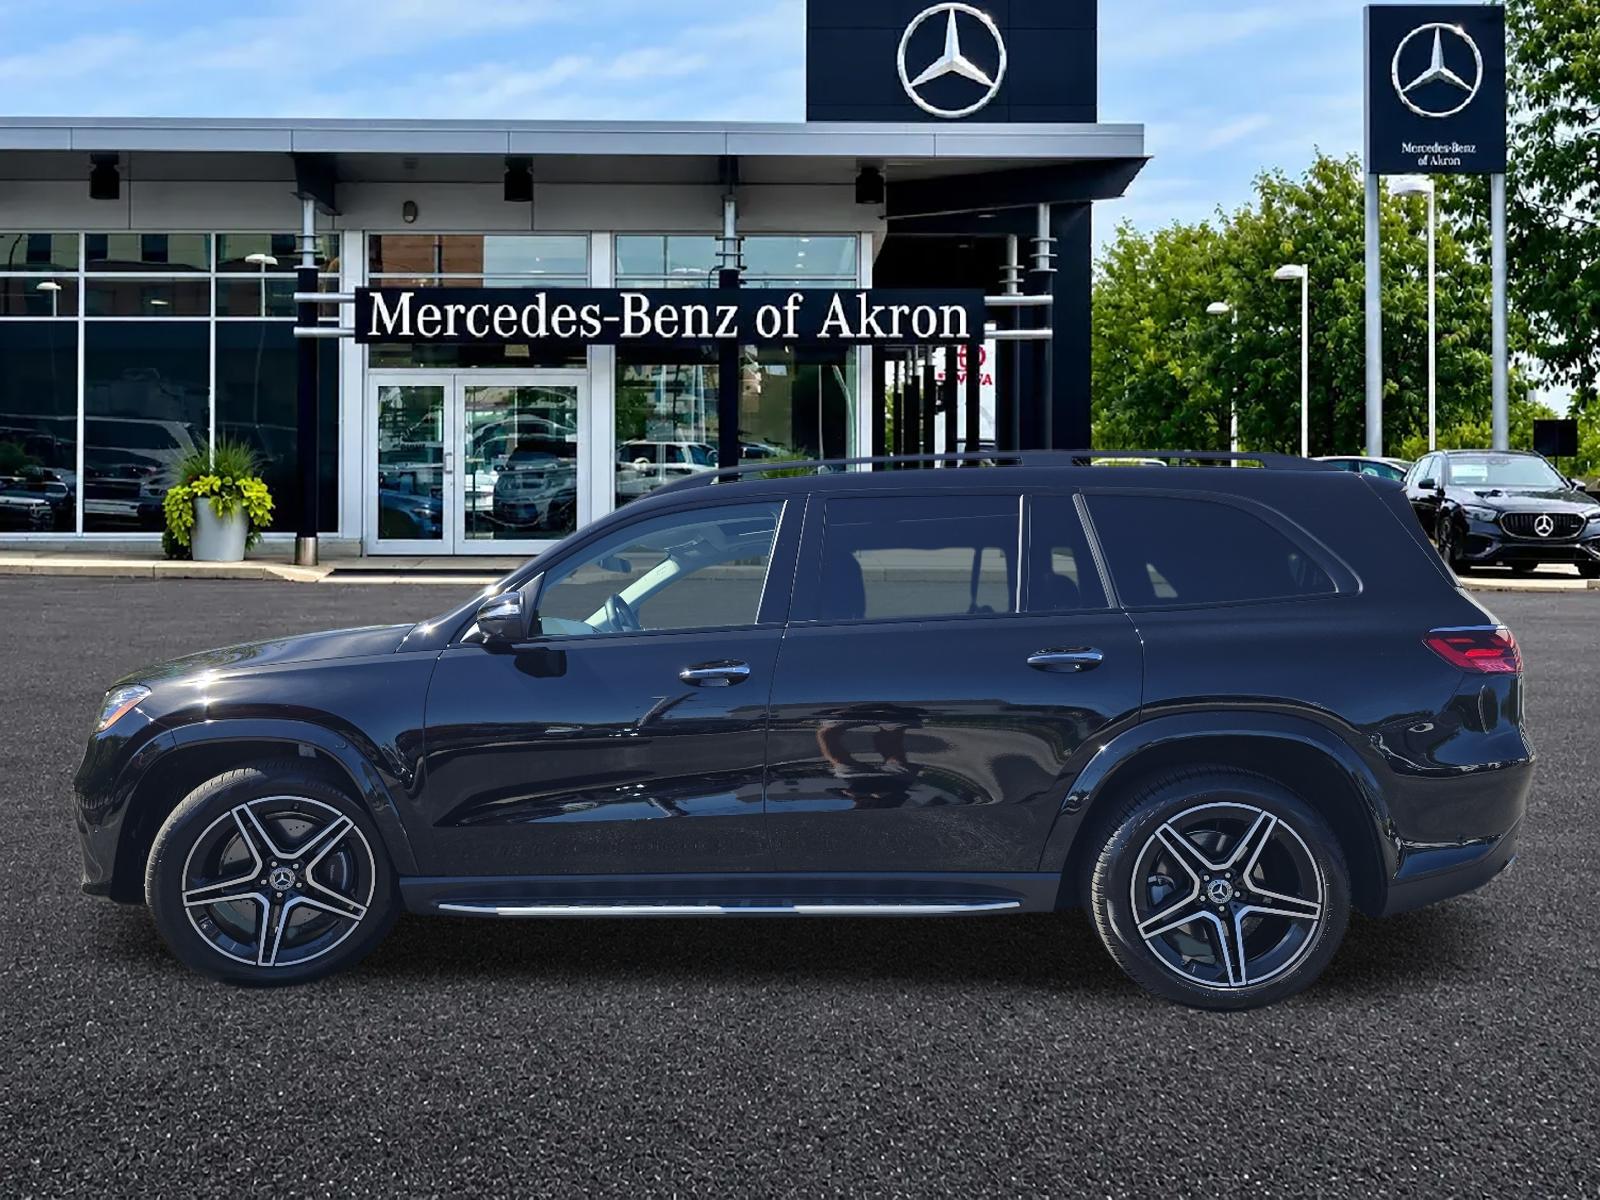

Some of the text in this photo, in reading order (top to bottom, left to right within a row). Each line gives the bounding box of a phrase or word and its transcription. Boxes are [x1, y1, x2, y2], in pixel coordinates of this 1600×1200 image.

[1401, 142, 1476, 153] Mercedes-Benz
[1417, 155, 1461, 166] of Akron
[367, 291, 971, 338] Mercedes-Benz of Akron
